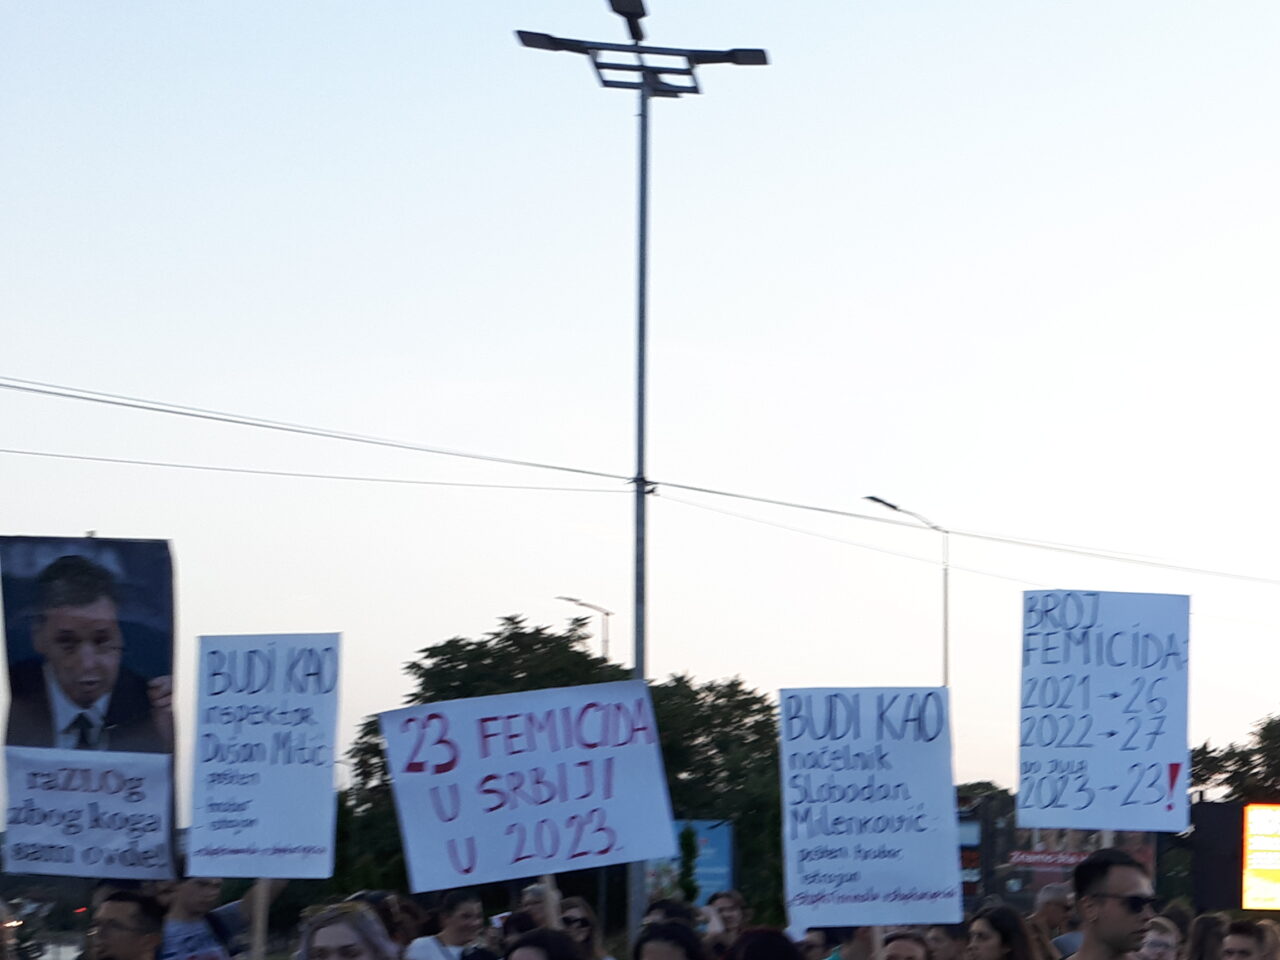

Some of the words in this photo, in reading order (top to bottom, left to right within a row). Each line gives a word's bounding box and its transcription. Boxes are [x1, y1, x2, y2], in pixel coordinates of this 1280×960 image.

[1023, 591, 1100, 631] BROJ
[206, 640, 279, 697] BUDI
[1021, 674, 1092, 711] 2021
[785, 693, 861, 741] BUDI
[876, 691, 944, 742] KAO
[1019, 713, 1094, 749] 2022
[1119, 715, 1167, 752] 27
[402, 712, 461, 776] 23
[476, 698, 658, 759] FEMICIDA
[429, 783, 462, 822] U
[477, 757, 615, 814] SRBIJI
[788, 774, 912, 805] Slobodan
[1018, 774, 1096, 811] 2023
[447, 836, 477, 876] U
